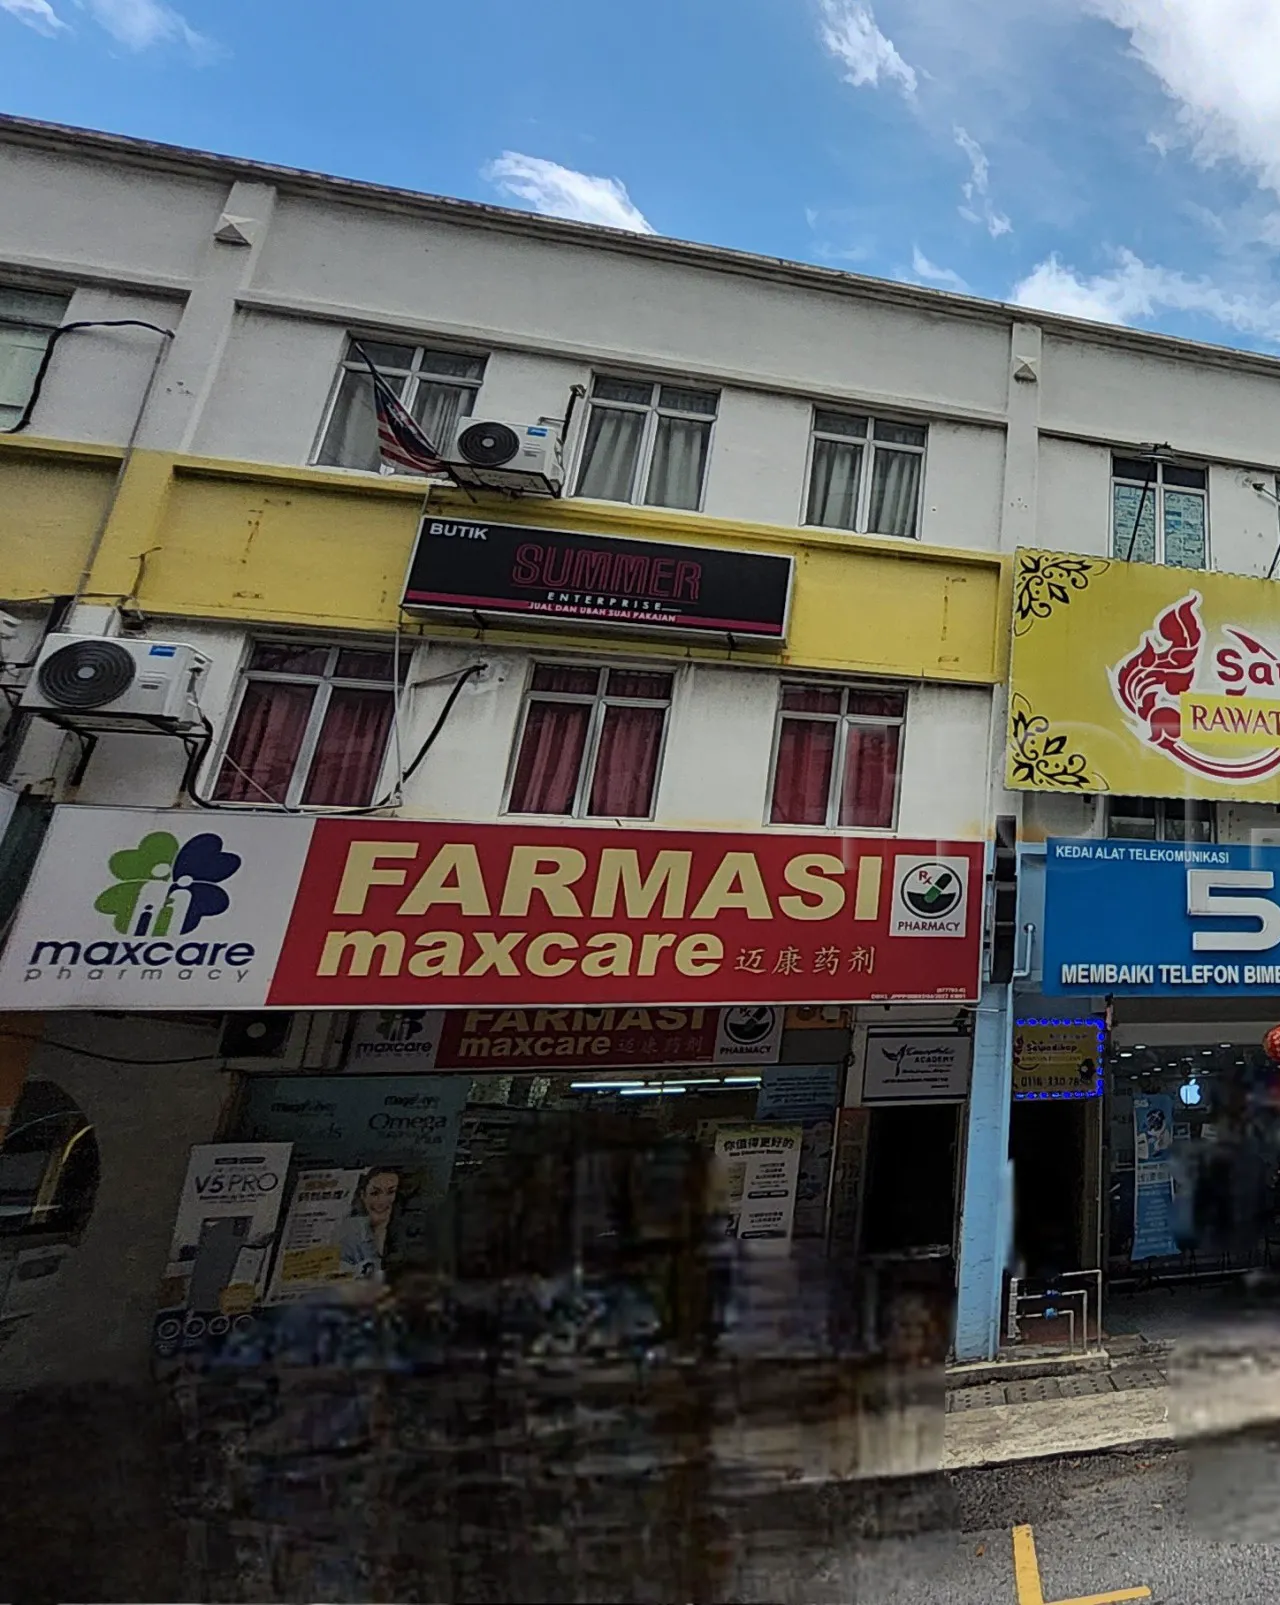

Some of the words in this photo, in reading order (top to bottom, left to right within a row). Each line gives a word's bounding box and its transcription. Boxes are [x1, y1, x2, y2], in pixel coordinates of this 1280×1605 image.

[429, 522, 489, 540] BUTIK
[511, 543, 702, 600] SUMMER
[528, 602, 553, 612] JUAL
[555, 604, 578, 614] DAN
[547, 591, 663, 611] ENTERPRISE
[1055, 845, 1094, 859] KEDAI
[1096, 847, 1126, 861] ALAT
[1127, 848, 1230, 865] TELEKOMUNIKASI
[333, 842, 882, 920] FARMASI
[897, 921, 961, 934] PHARMACY
[28, 939, 256, 967] maxcare
[316, 929, 725, 979] maxcare
[733, 946, 875, 976] 迈康药剂
[24, 967, 250, 983] pharmacy
[1061, 963, 1154, 985] MEMBAIKI
[1158, 964, 1240, 985] TELEFON
[356, 1040, 433, 1054] maxcare
[457, 1034, 611, 1058] maxcare
[720, 1045, 772, 1055] PHARMACY
[369, 1112, 448, 1132] Omega
